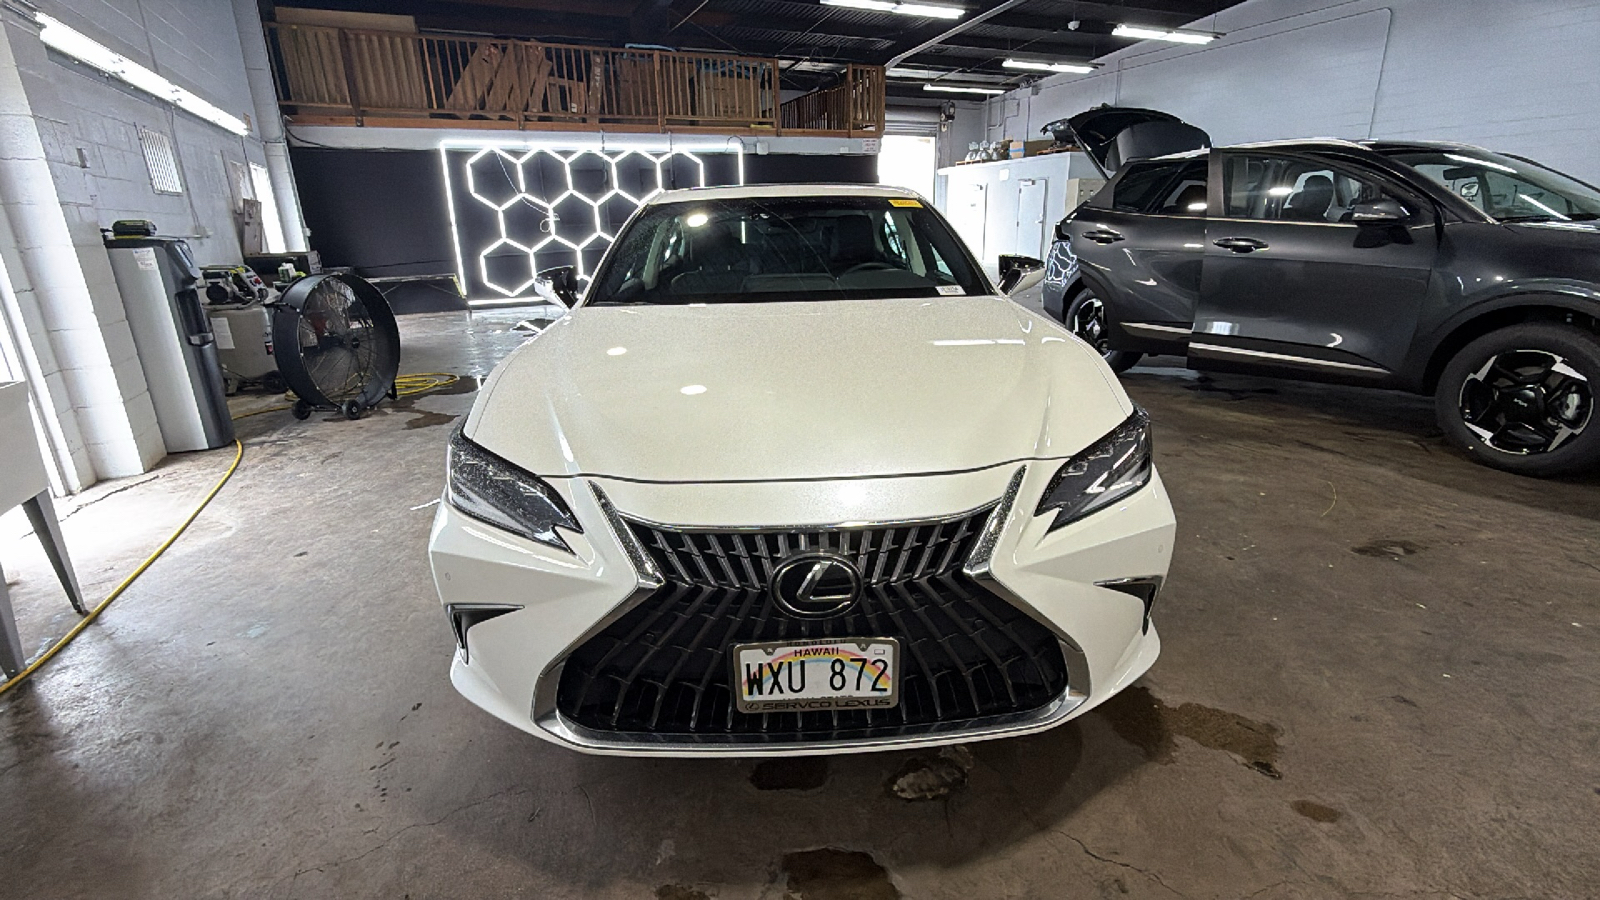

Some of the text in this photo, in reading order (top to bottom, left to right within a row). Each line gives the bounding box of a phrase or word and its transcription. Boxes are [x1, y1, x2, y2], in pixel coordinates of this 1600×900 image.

[794, 647, 839, 657] HAWAII
[745, 658, 888, 696] WXU 872
[763, 699, 891, 711] SERVCO LEXUS
